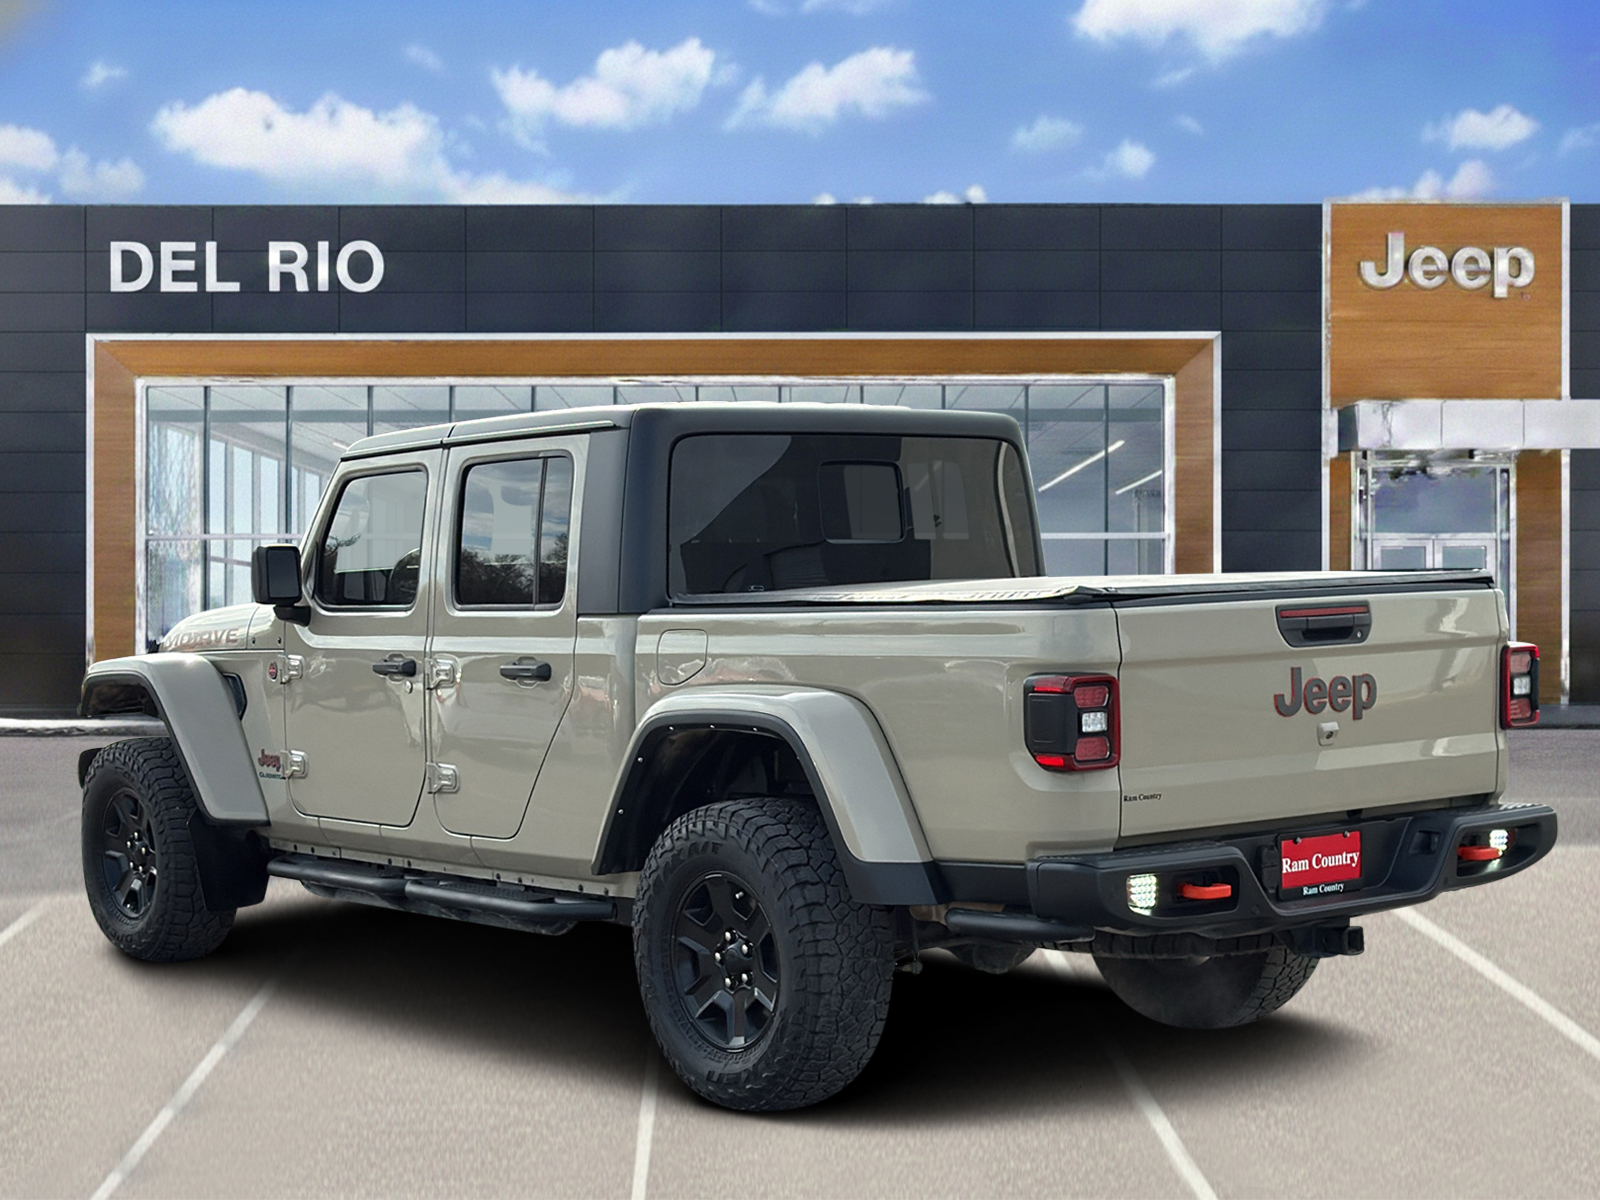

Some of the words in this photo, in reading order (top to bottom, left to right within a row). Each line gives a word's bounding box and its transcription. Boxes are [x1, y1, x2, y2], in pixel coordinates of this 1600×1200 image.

[109, 241, 240, 293] DEL
[268, 240, 385, 294] RIO
[1360, 231, 1534, 298] Jeep
[1273, 667, 1377, 721] Jeep
[1282, 857, 1309, 874] Ram
[1312, 851, 1360, 868] Country
[1303, 886, 1318, 895] Ram
[1319, 883, 1345, 893] Country
